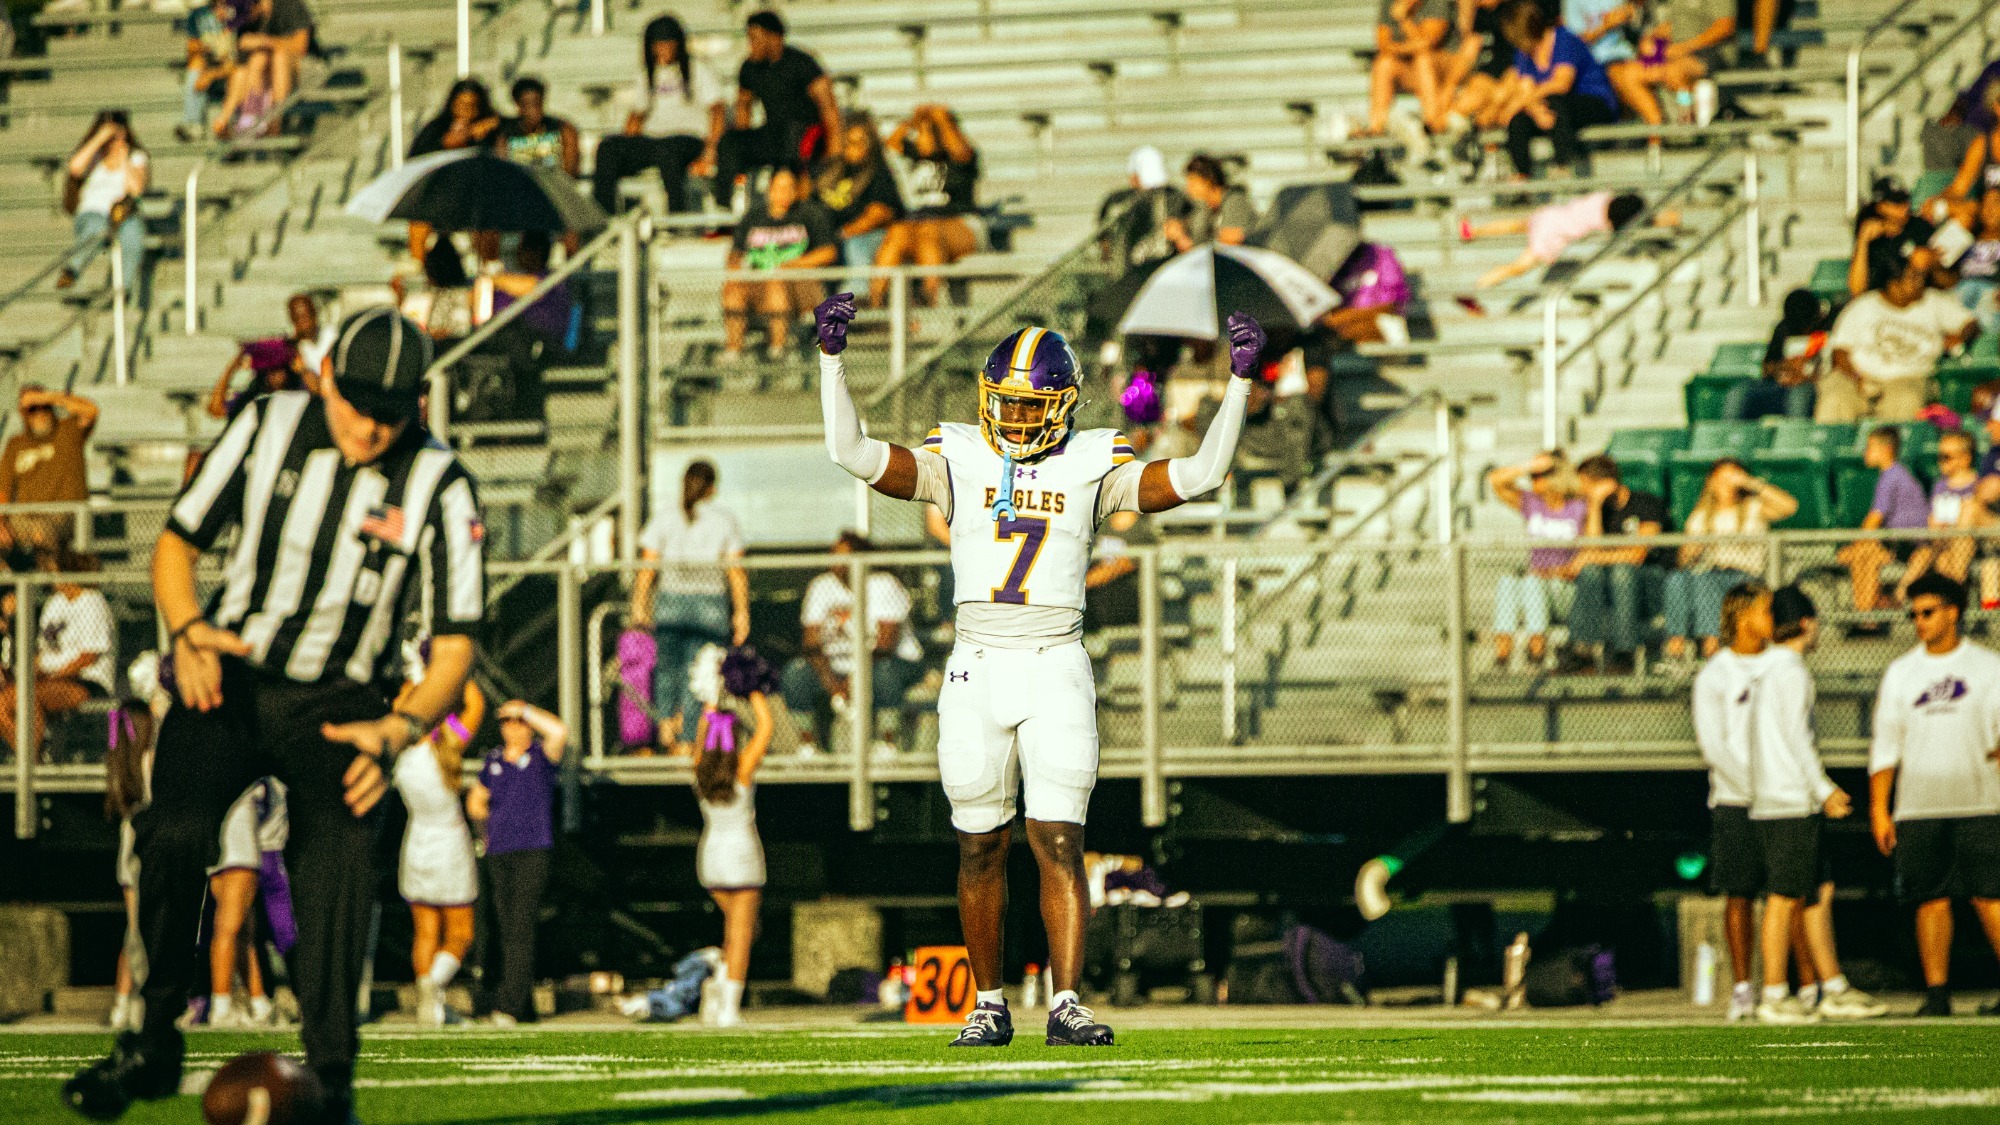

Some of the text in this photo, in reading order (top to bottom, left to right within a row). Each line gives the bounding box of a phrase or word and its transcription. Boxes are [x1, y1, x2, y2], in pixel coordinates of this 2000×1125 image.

[984, 486, 1066, 514] EGLES
[991, 513, 1050, 605] 7
[916, 957, 970, 1012] 30
